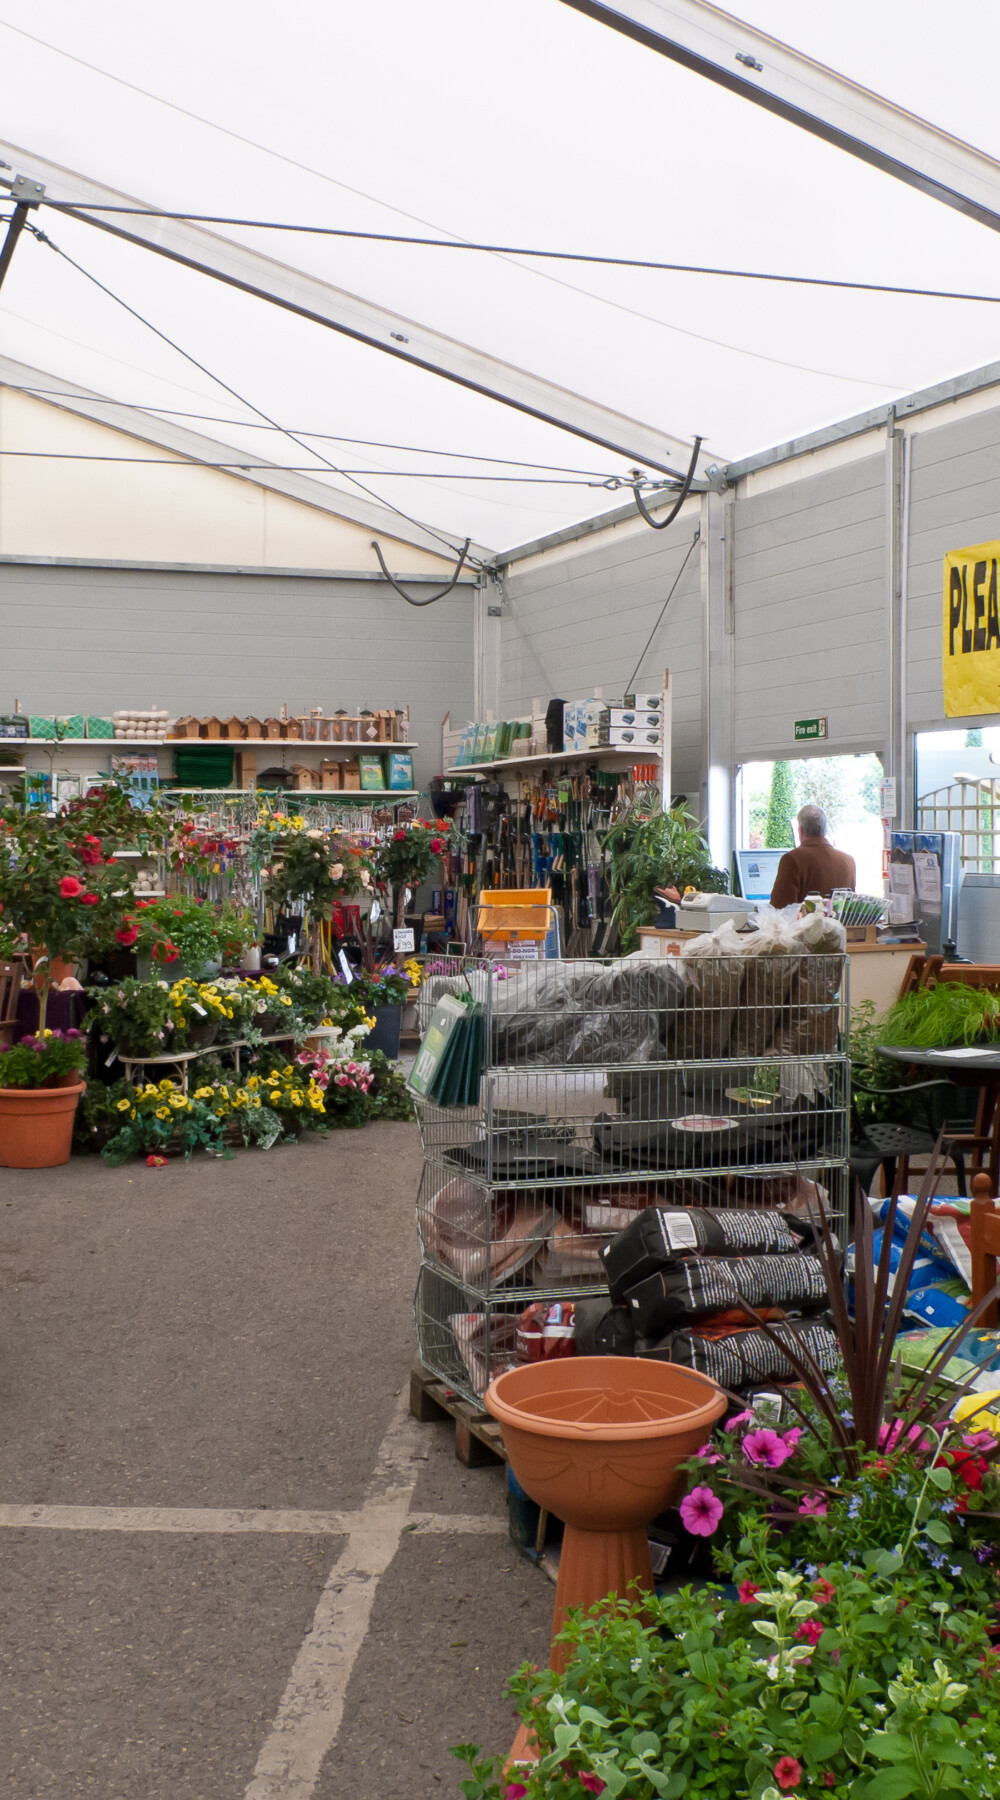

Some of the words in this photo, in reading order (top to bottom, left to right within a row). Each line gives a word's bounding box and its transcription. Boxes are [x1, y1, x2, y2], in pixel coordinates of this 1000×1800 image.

[949, 558, 1000, 656] PLEA
[795, 725, 806, 735] Fire
[806, 724, 817, 734] exit
